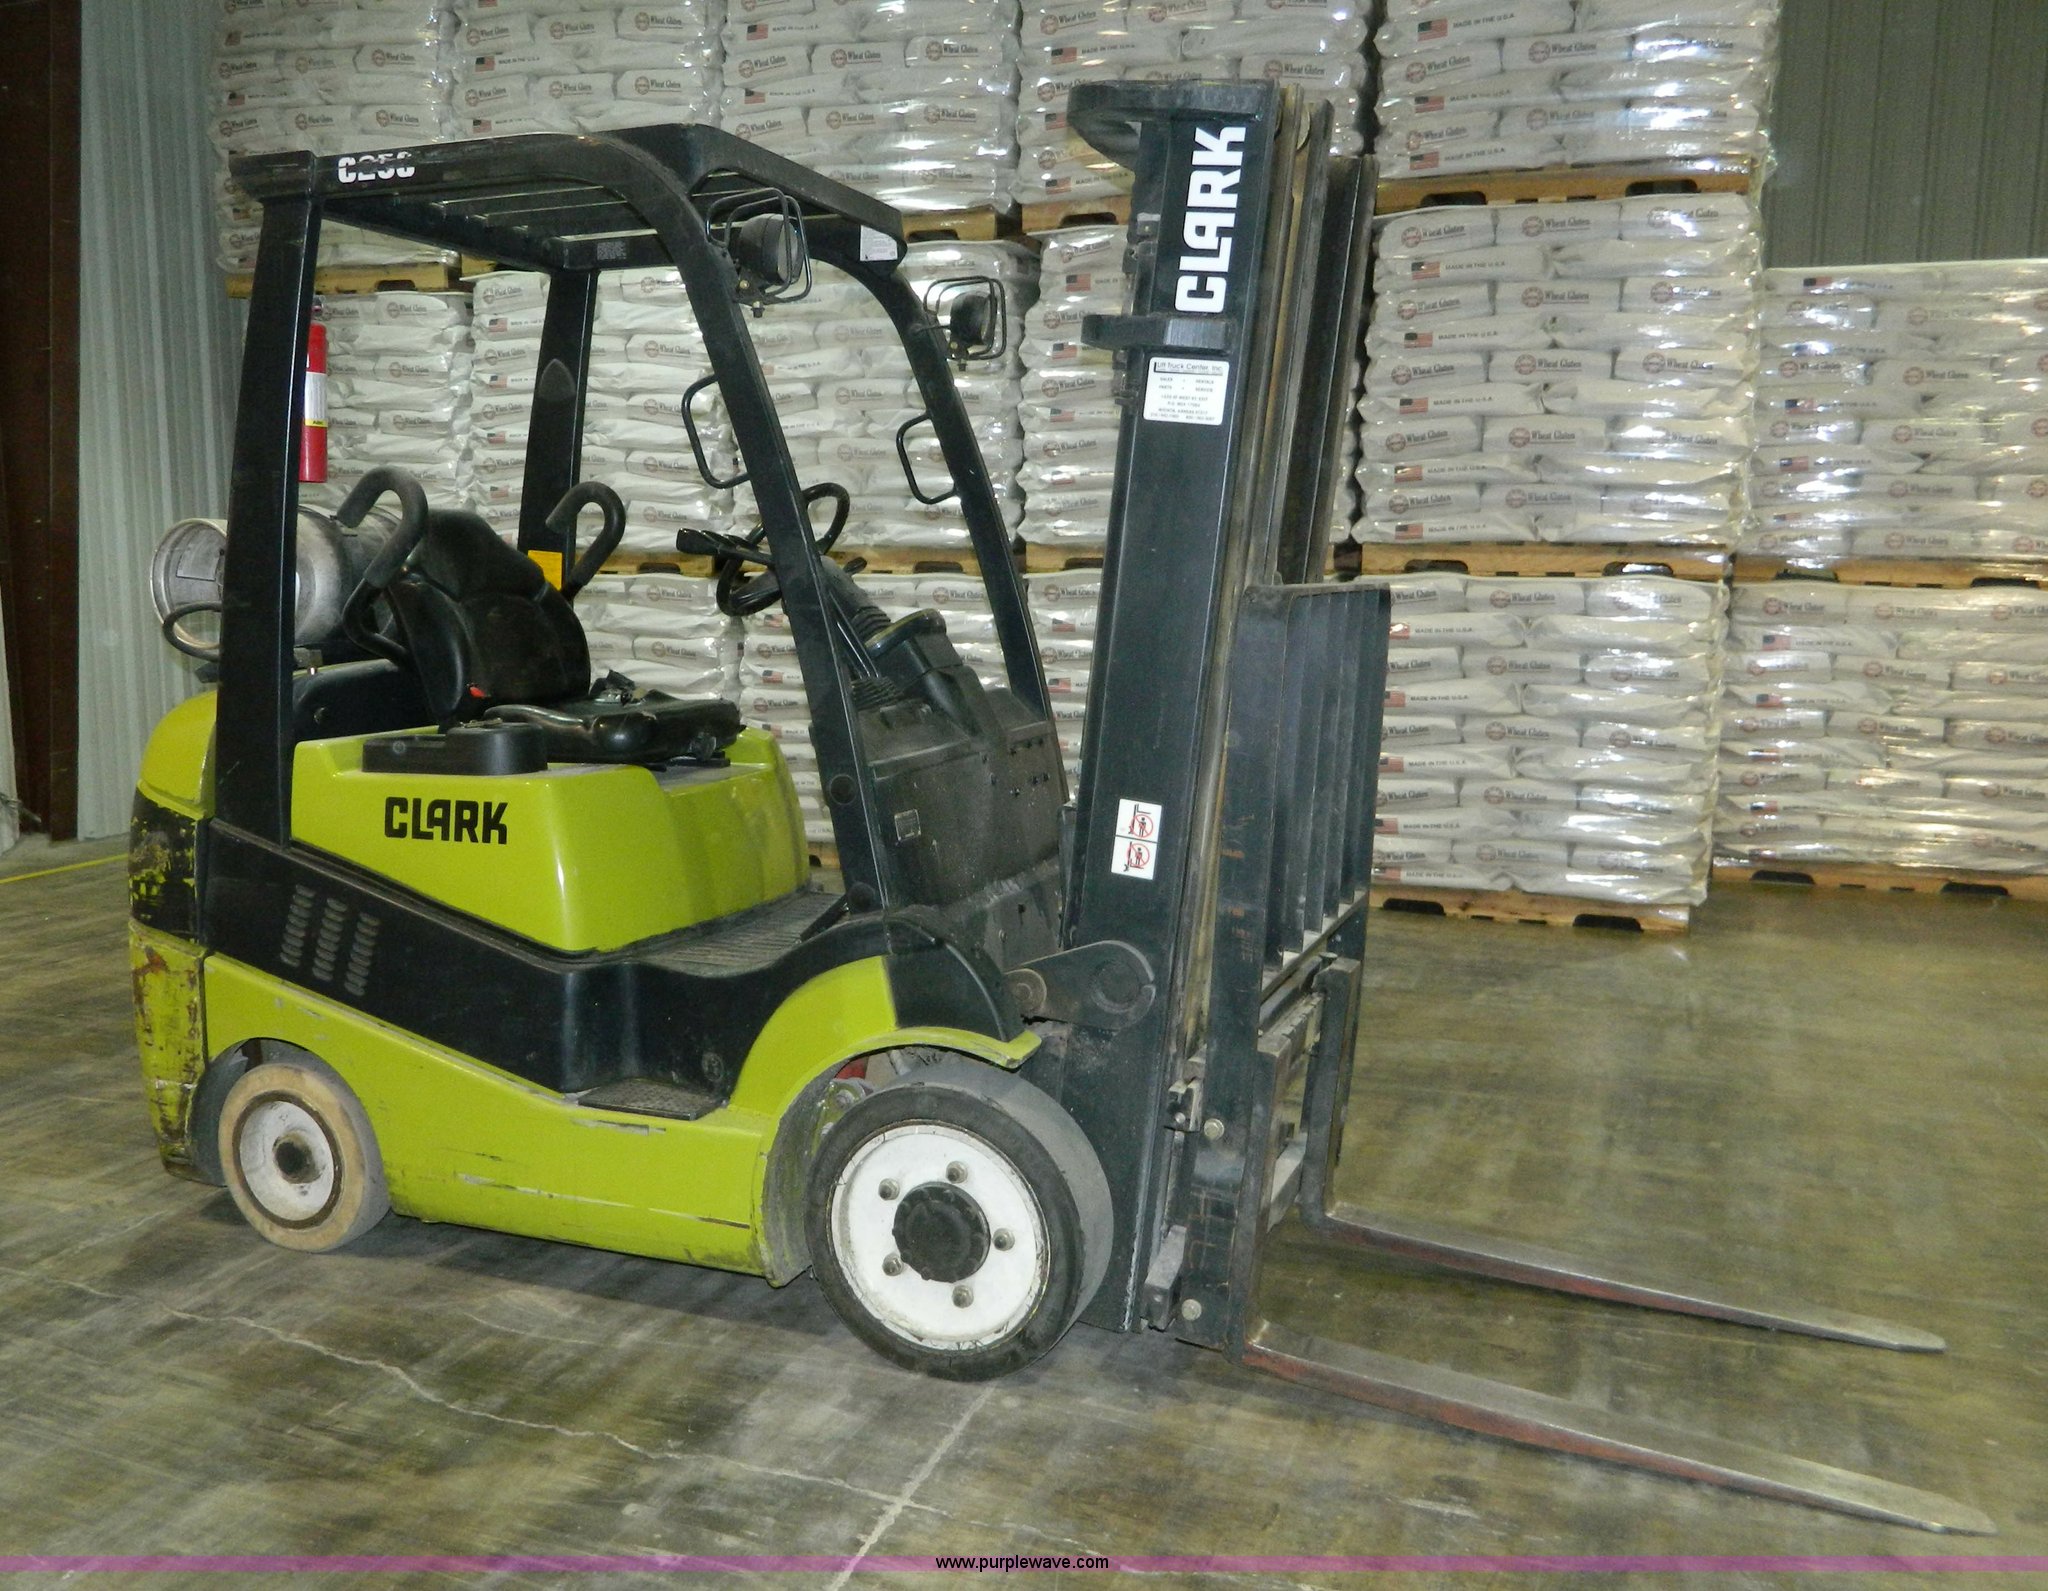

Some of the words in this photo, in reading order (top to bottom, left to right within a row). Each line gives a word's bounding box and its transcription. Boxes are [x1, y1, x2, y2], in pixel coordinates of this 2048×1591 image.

[1174, 126, 1246, 313] CLARK
[1412, 365, 1432, 375] Wheat
[1433, 362, 1454, 372] Gluten
[1538, 358, 1558, 368] Wheat
[1560, 359, 1581, 368] Gluten
[1407, 433, 1426, 442] Wheat
[1427, 430, 1448, 438] Gluten
[1531, 430, 1552, 440] Wheat
[1554, 430, 1576, 440] Gluten
[1389, 662, 1409, 670] Wheat
[1411, 660, 1431, 668] Gluten
[1388, 726, 1408, 734] Wheat
[1409, 725, 1429, 733] Gluten
[1507, 726, 1525, 736] Wheat
[1527, 728, 1550, 738] Gluten
[1388, 791, 1407, 799] Wheat
[1408, 790, 1429, 798] Gluten
[384, 797, 508, 845] CLARK
